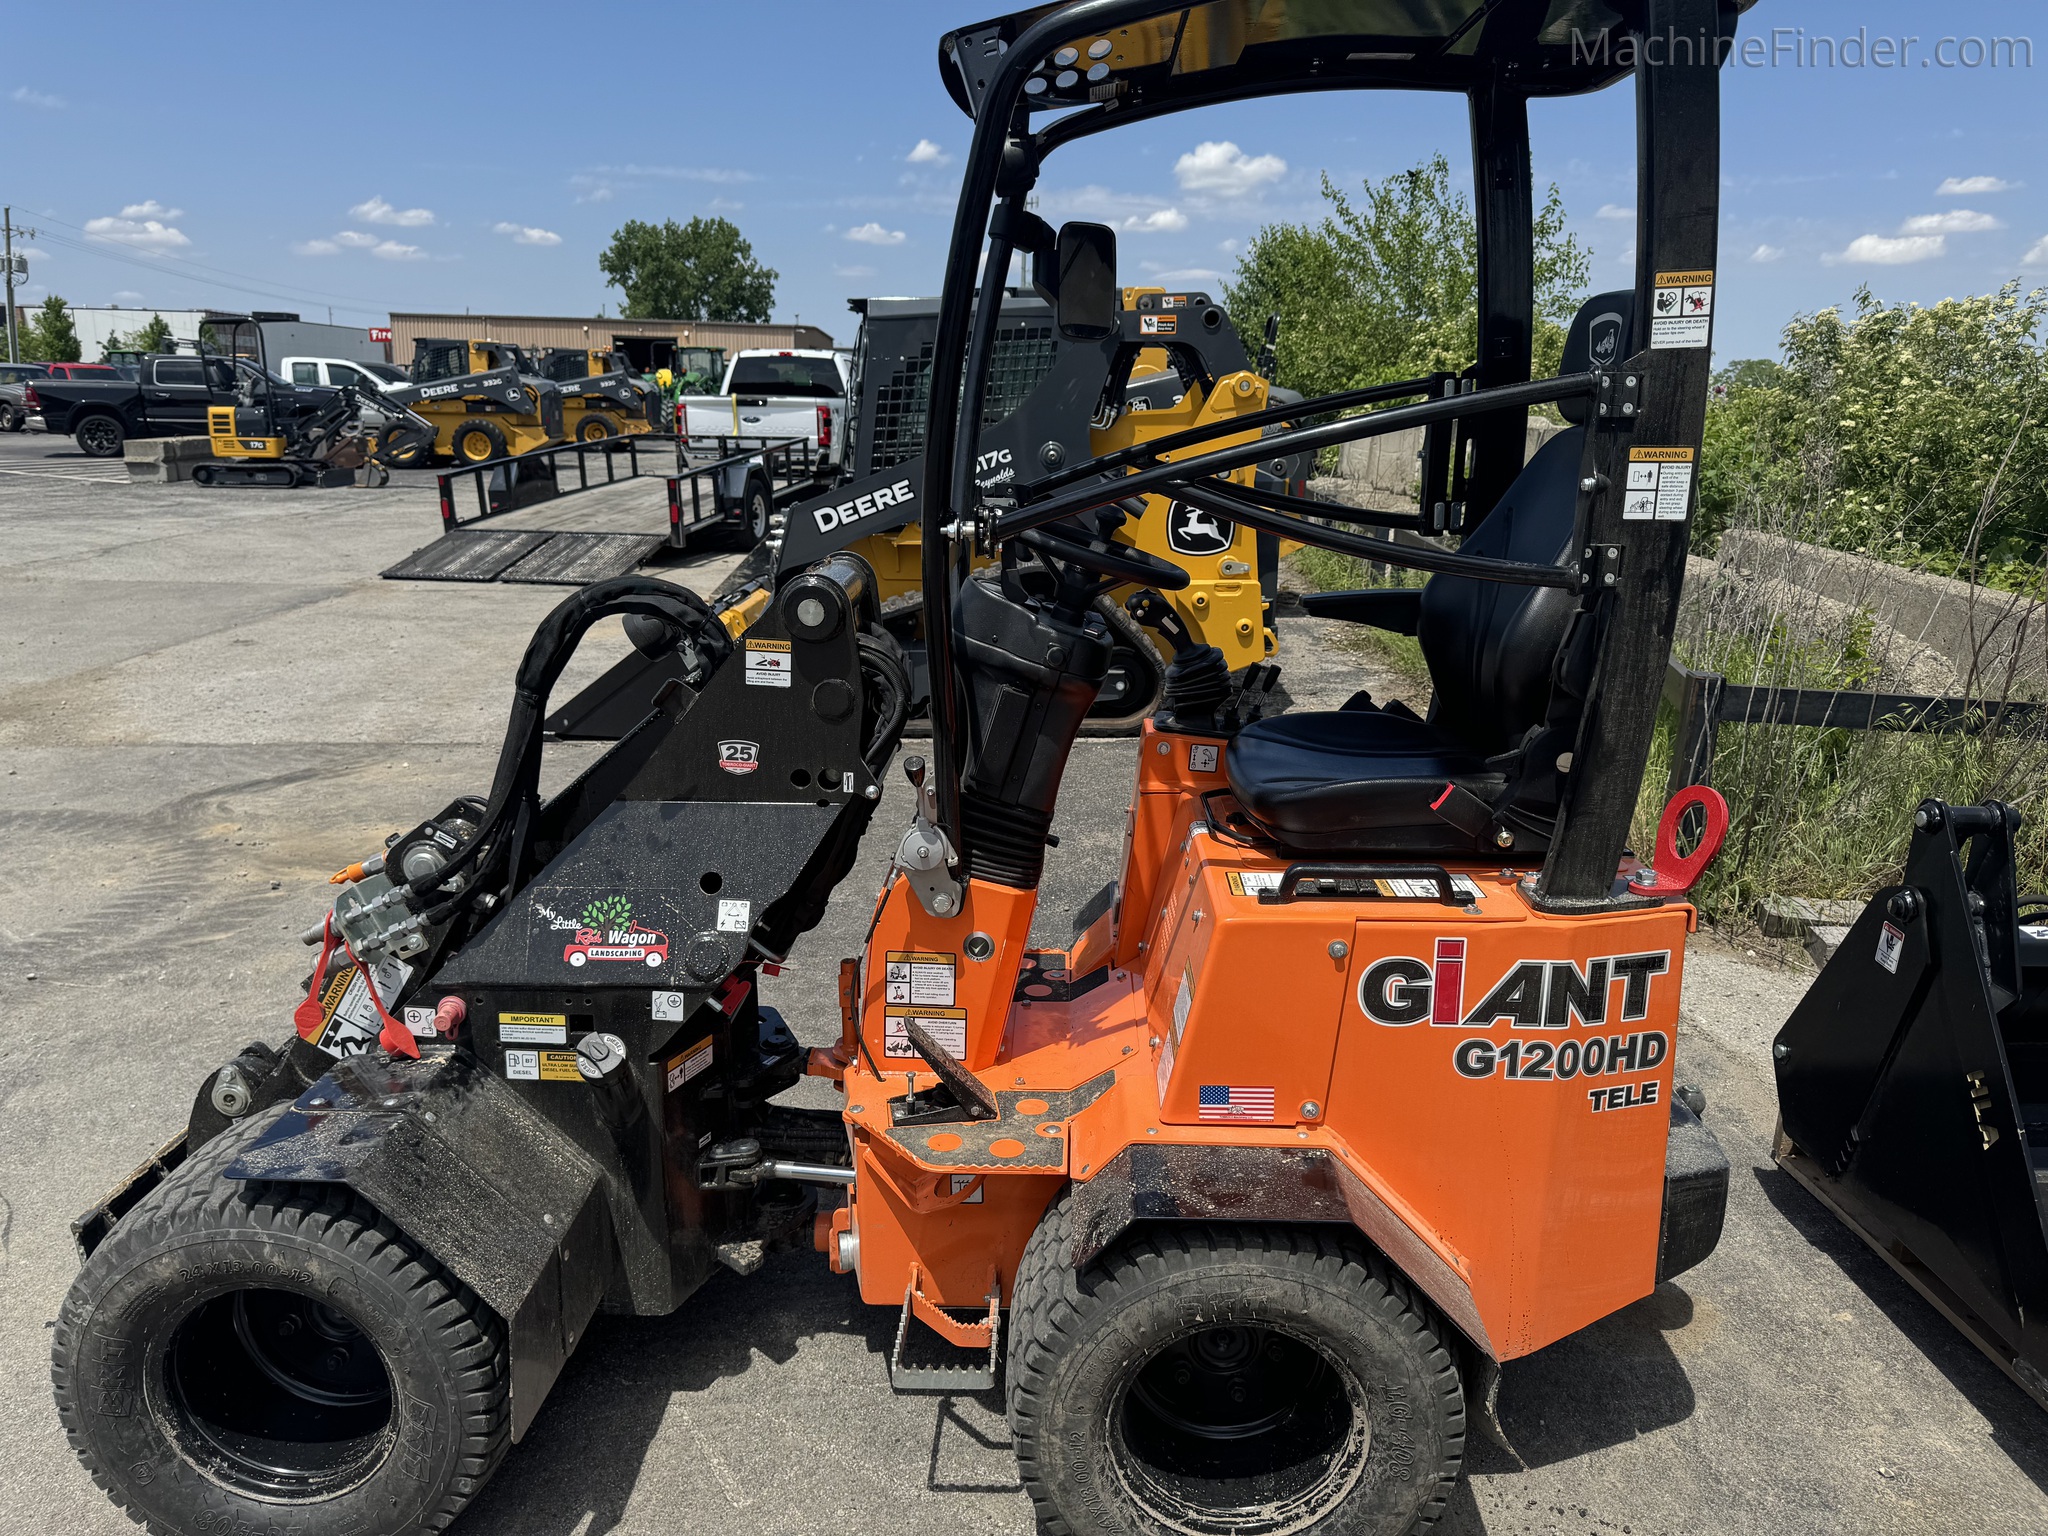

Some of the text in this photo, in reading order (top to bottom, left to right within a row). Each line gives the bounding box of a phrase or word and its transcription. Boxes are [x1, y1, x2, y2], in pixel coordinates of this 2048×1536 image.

[1666, 275, 1711, 283] WARNING
[420, 384, 459, 398] DEERE
[560, 384, 580, 393] EERE
[355, 394, 379, 409] DEERE
[813, 479, 915, 534] DEERE
[725, 746, 752, 761] 25
[538, 907, 556, 920] My
[550, 916, 583, 930] Little
[575, 928, 656, 948] Red Wagon
[606, 1037, 622, 1052] DIESEL
[1453, 1030, 1669, 1081] G1200HD
[581, 1060, 596, 1074] DIESEL
[1587, 1080, 1661, 1113] TELE
[180, 1259, 313, 1284] 24X13.00-12
[1378, 1385, 1416, 1482] LG-408
